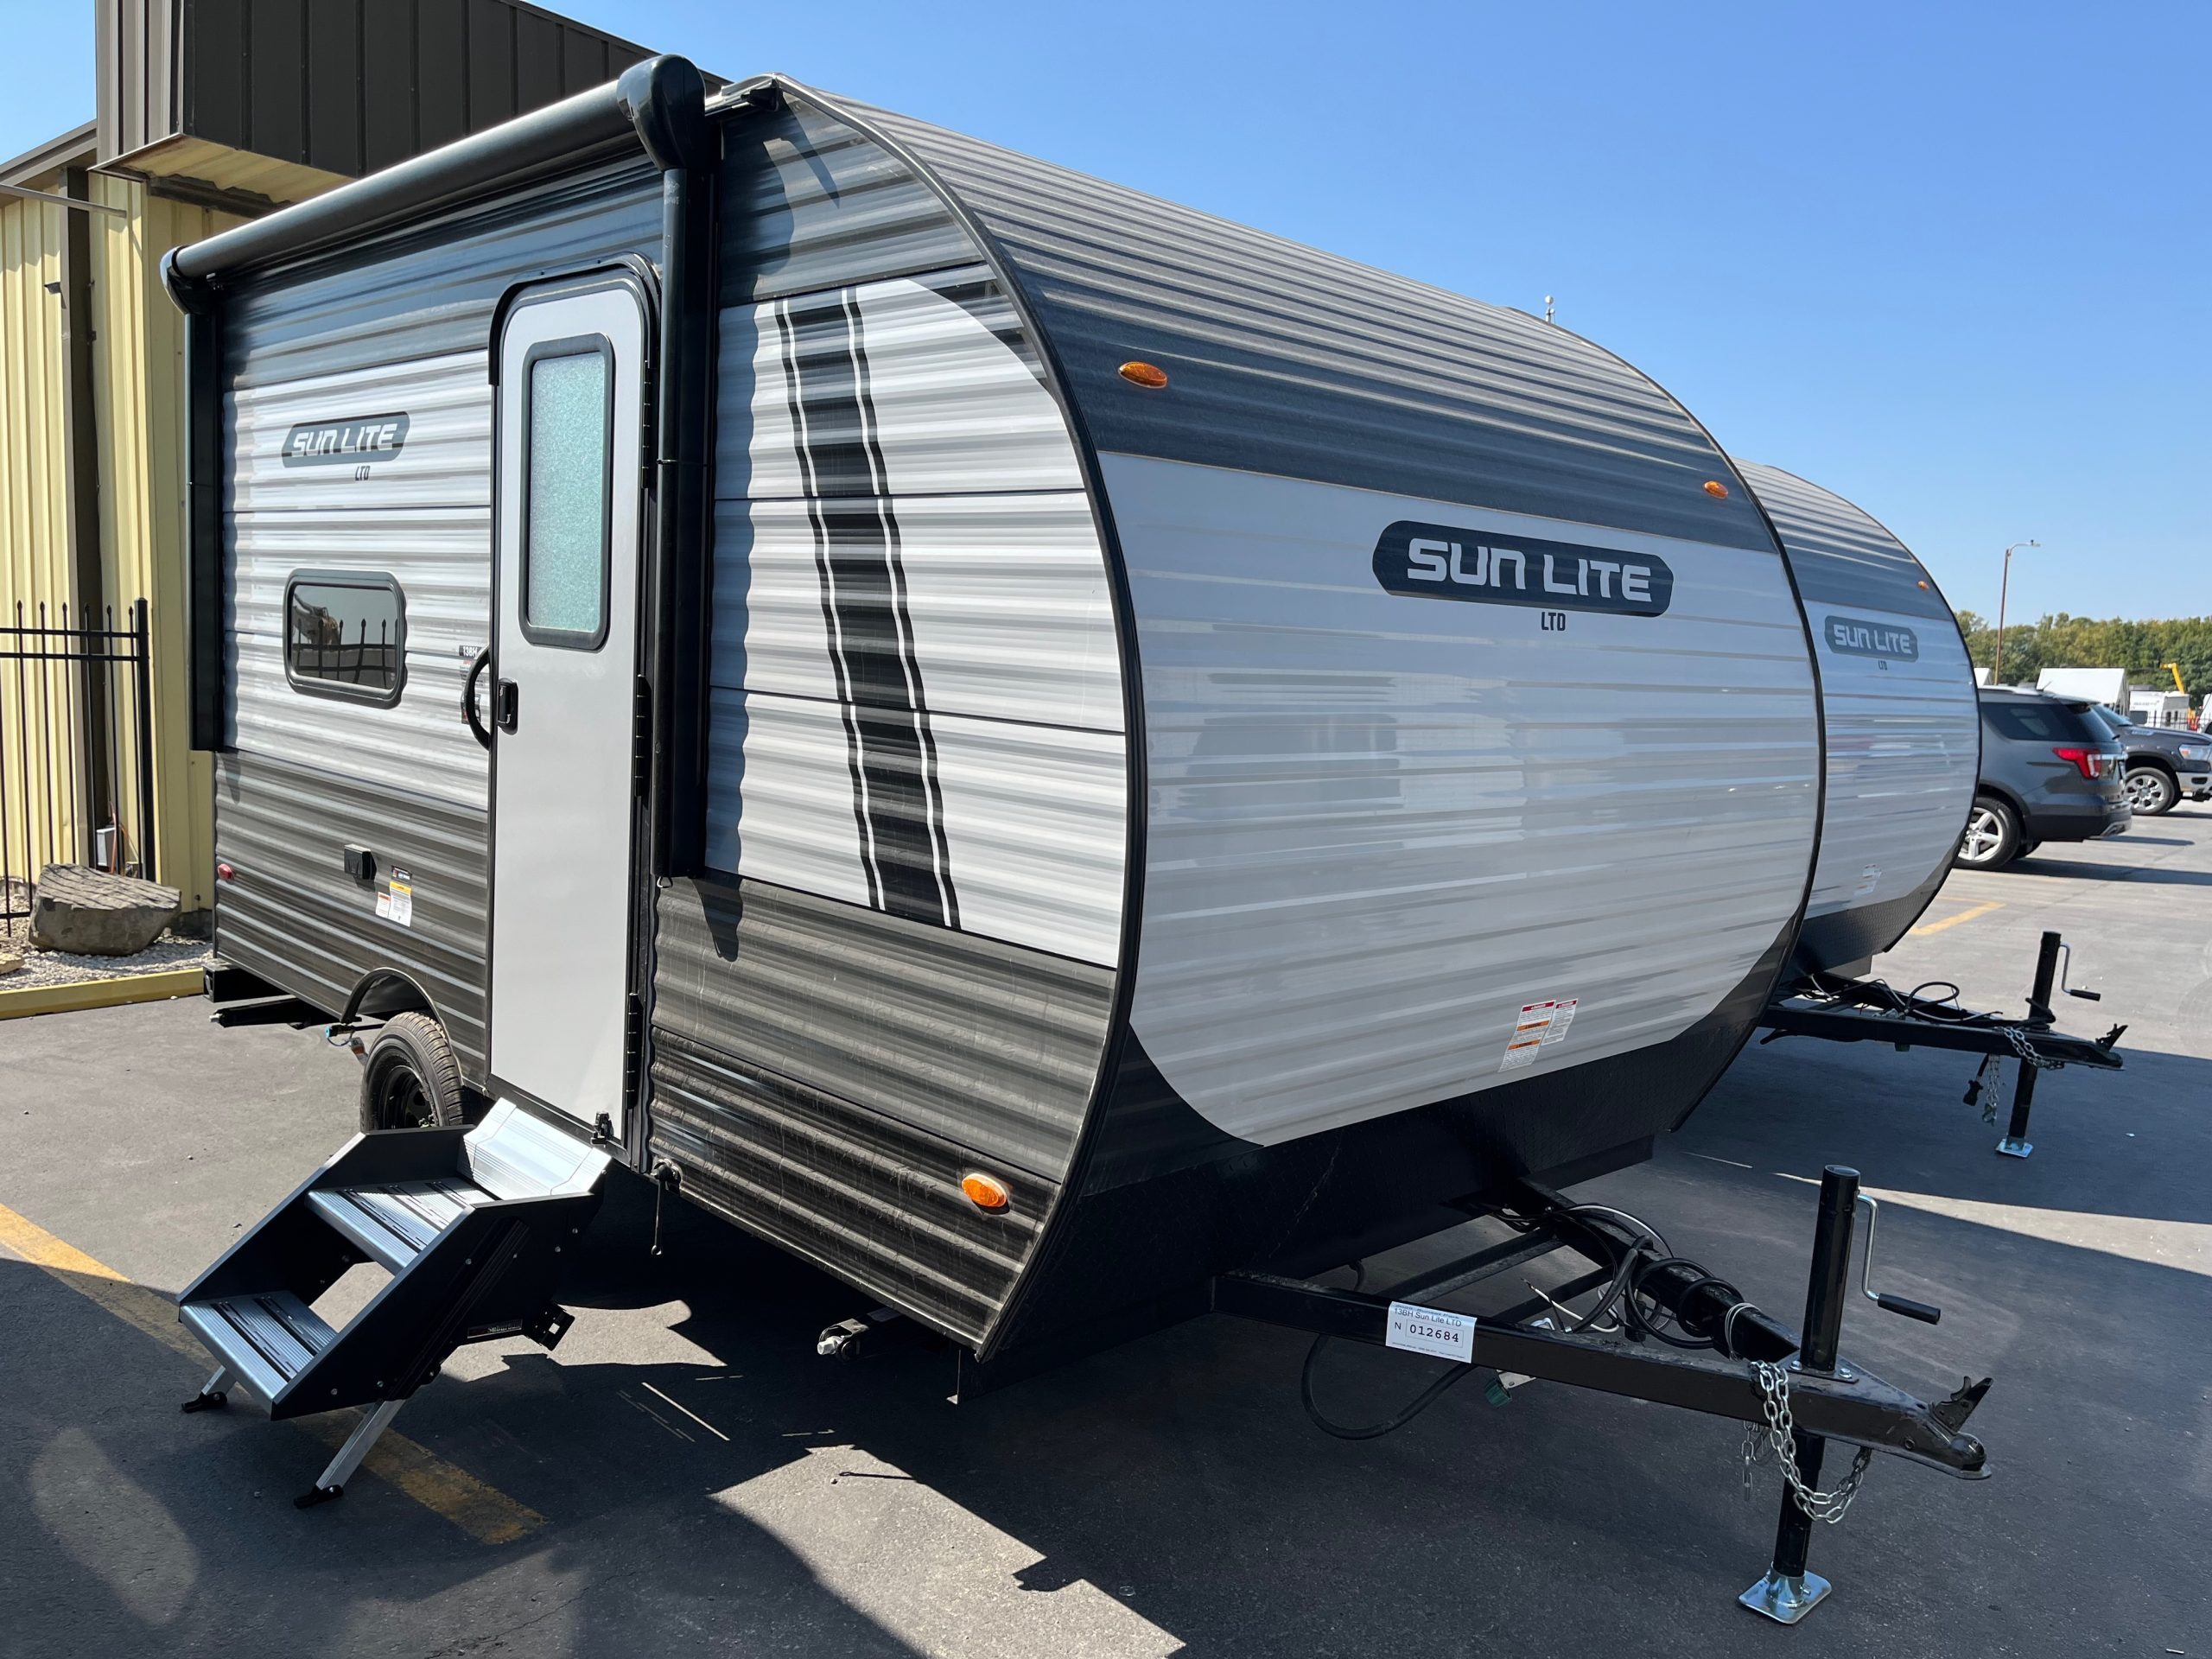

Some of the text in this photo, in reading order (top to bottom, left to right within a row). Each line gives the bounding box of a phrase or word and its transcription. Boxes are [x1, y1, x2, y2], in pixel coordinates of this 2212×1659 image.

[291, 423, 397, 457] SUN LITE
[355, 465, 371, 481] LTD
[1407, 537, 1652, 602] SUN LITE
[1541, 612, 1566, 632] LTD
[1834, 624, 1913, 654] SUN LITE
[462, 645, 478, 658] 13BH
[1395, 1308, 1414, 1318] 13BH
[1415, 1312, 1430, 1321] Sun
[1431, 1314, 1445, 1324] Lite
[1446, 1318, 1462, 1327] LTD
[1394, 1321, 1459, 1343] N 012684
